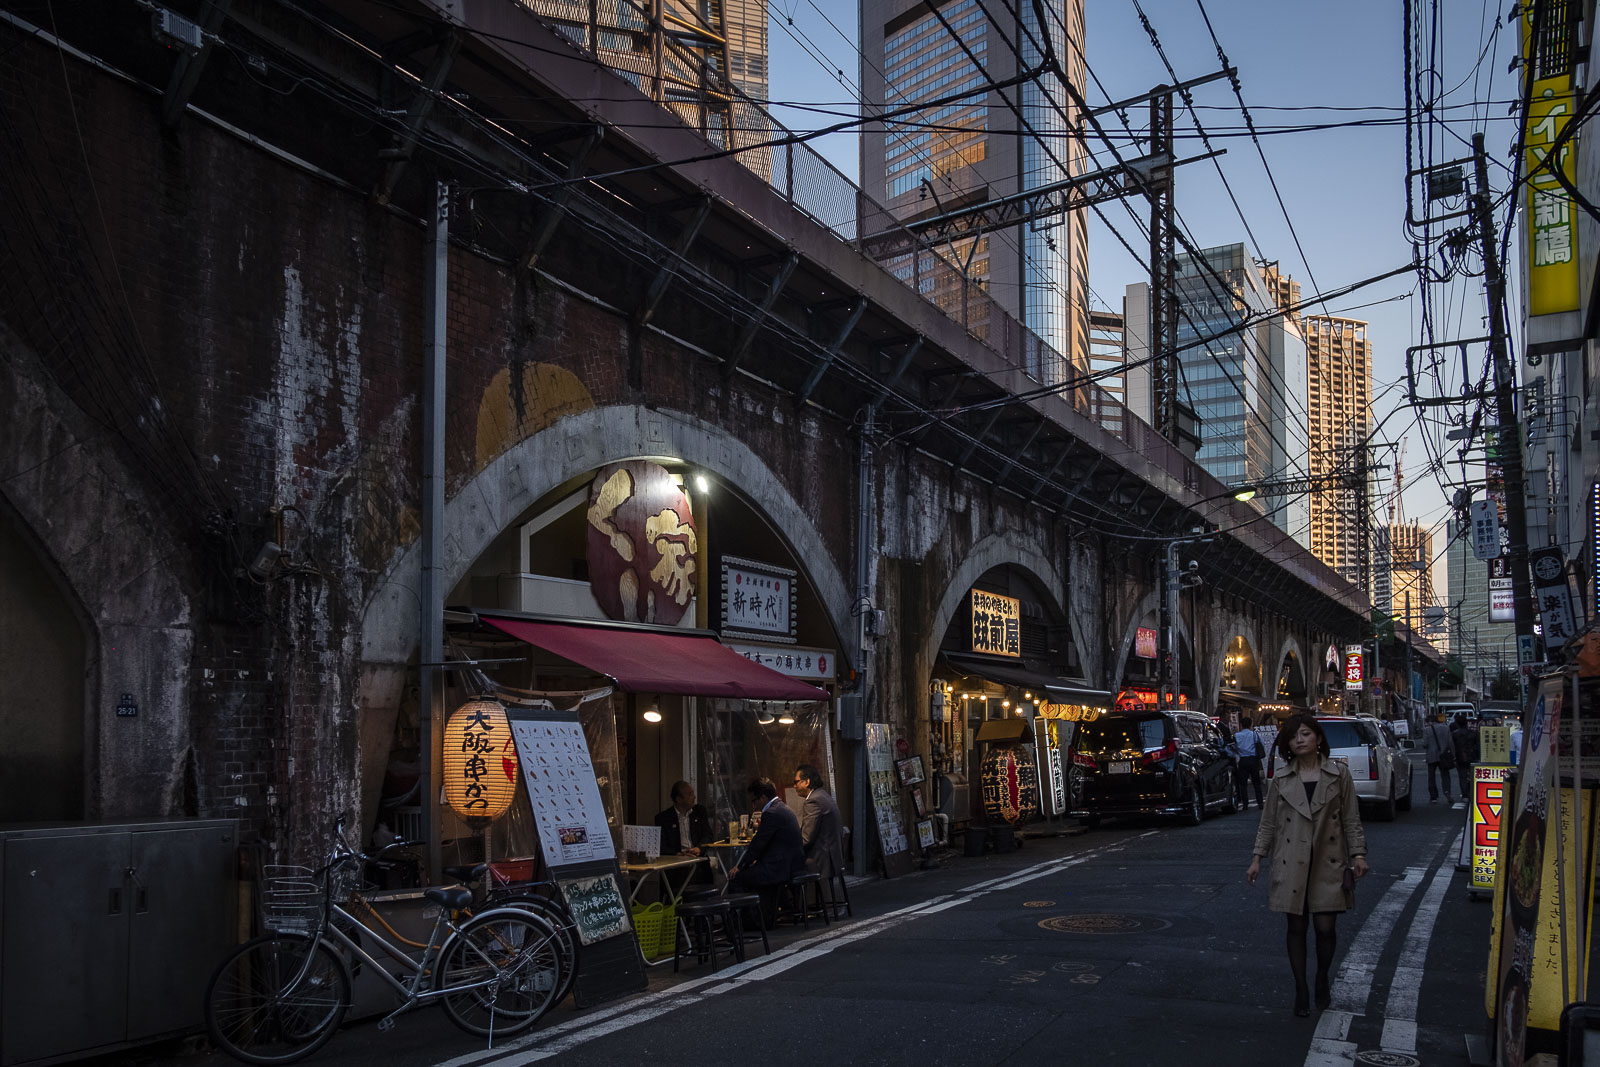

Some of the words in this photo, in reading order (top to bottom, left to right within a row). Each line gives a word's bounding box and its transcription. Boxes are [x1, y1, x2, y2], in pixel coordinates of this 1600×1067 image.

[732, 588, 777, 621] 新時代
[974, 592, 1012, 615] 本物のやきとん
[974, 610, 1019, 655] 筑前屋
[1347, 656, 1361, 680] 王将
[462, 710, 495, 809] 大阪串かつ
[1475, 848, 1498, 857] 新作
[1474, 875, 1493, 884] SEX
